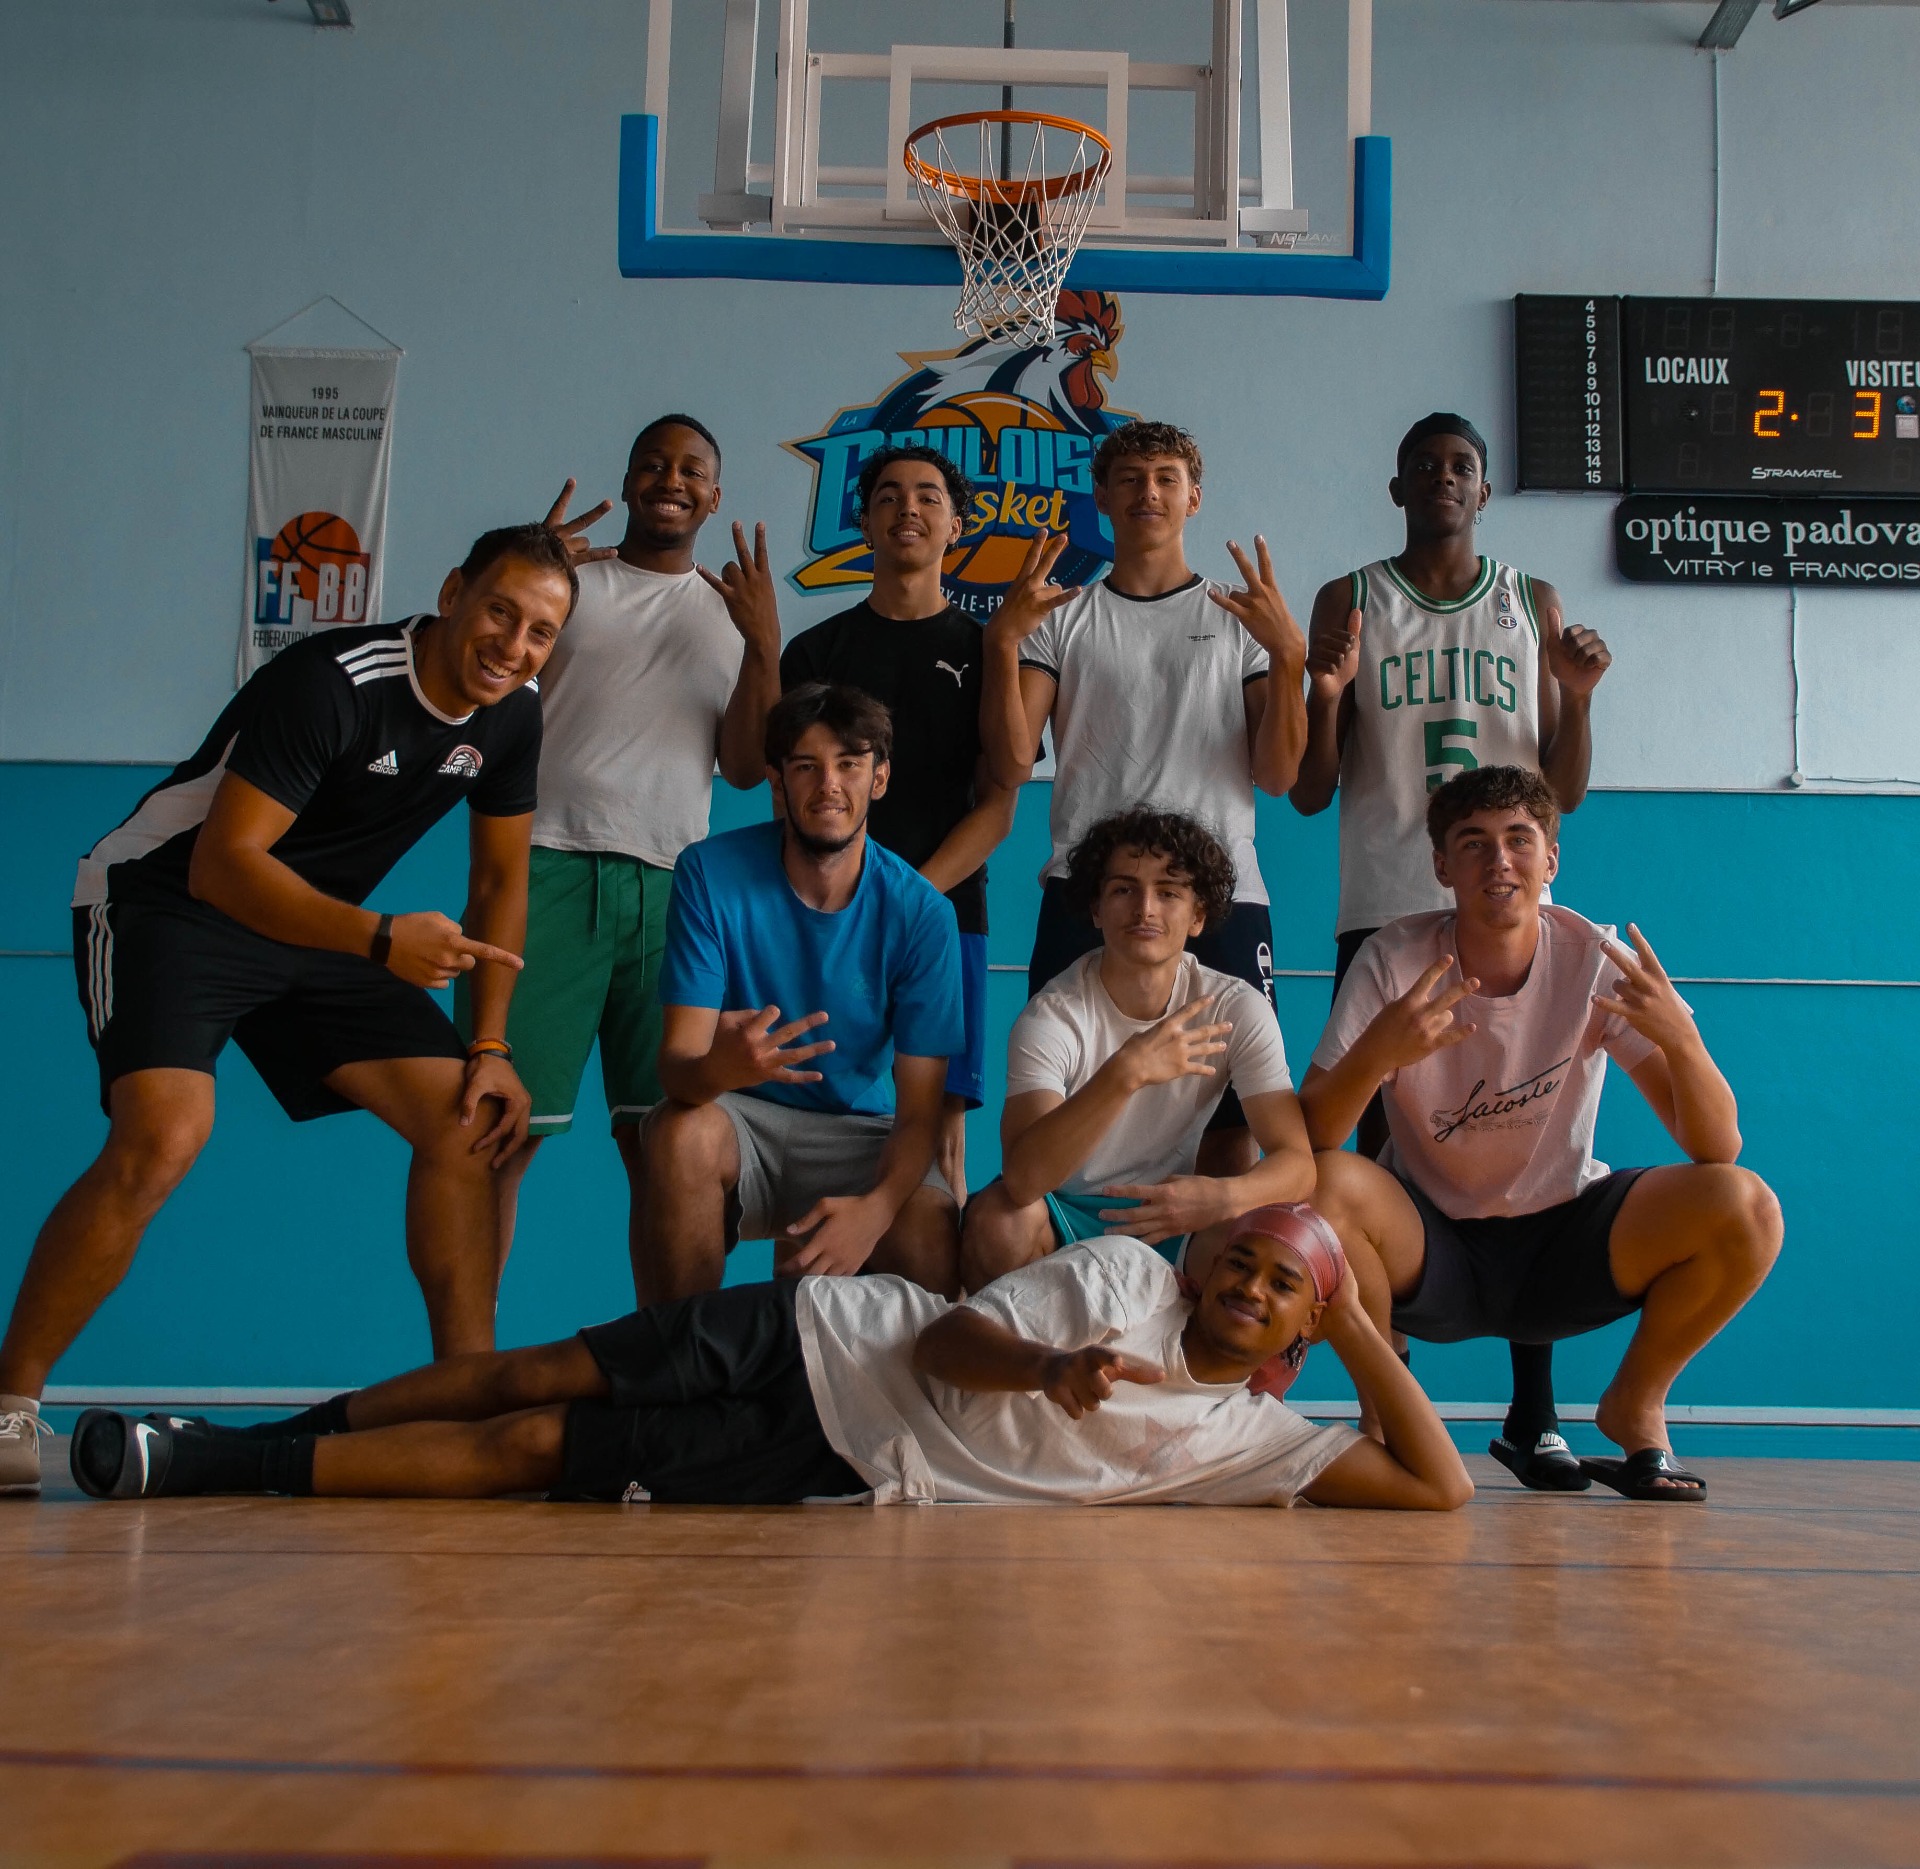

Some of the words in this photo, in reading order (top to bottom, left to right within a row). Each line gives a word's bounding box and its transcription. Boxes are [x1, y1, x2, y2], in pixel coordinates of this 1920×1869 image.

[1585, 300, 1595, 312] 4
[1586, 315, 1596, 328] 5
[1586, 331, 1596, 343] 6
[1586, 346, 1596, 359] 7
[1586, 362, 1597, 375] 8
[1645, 357, 1729, 385] LOCAUX
[1587, 377, 1597, 390] 9
[312, 387, 339, 399] 1995
[1584, 392, 1600, 406] 10
[262, 405, 319, 419] VAINQUEUR
[322, 407, 335, 420] DE
[338, 407, 350, 420] LA
[353, 407, 385, 420] COUPE
[1585, 408, 1600, 421] 11
[1853, 391, 1881, 438] 3
[841, 415, 857, 427] LA
[260, 425, 275, 438] DE
[277, 425, 319, 439] FRANCE
[322, 427, 383, 440] MASCULINE
[1585, 424, 1601, 437] 12
[1585, 439, 1601, 452] 13
[1585, 455, 1601, 468] 14
[1585, 470, 1602, 484] 15
[1751, 467, 1842, 480] STRAMATEL
[962, 481, 1070, 536] sket
[1625, 506, 1771, 556] optique
[1664, 559, 1745, 576] VITRY
[1752, 561, 1773, 577] le
[1790, 562, 1920, 580] FRANÇOIS
[1380, 647, 1516, 713] CELTICS
[1423, 718, 1478, 794] 5
[368, 762, 399, 775] adidas
[1434, 1056, 1572, 1143] Lacoste
